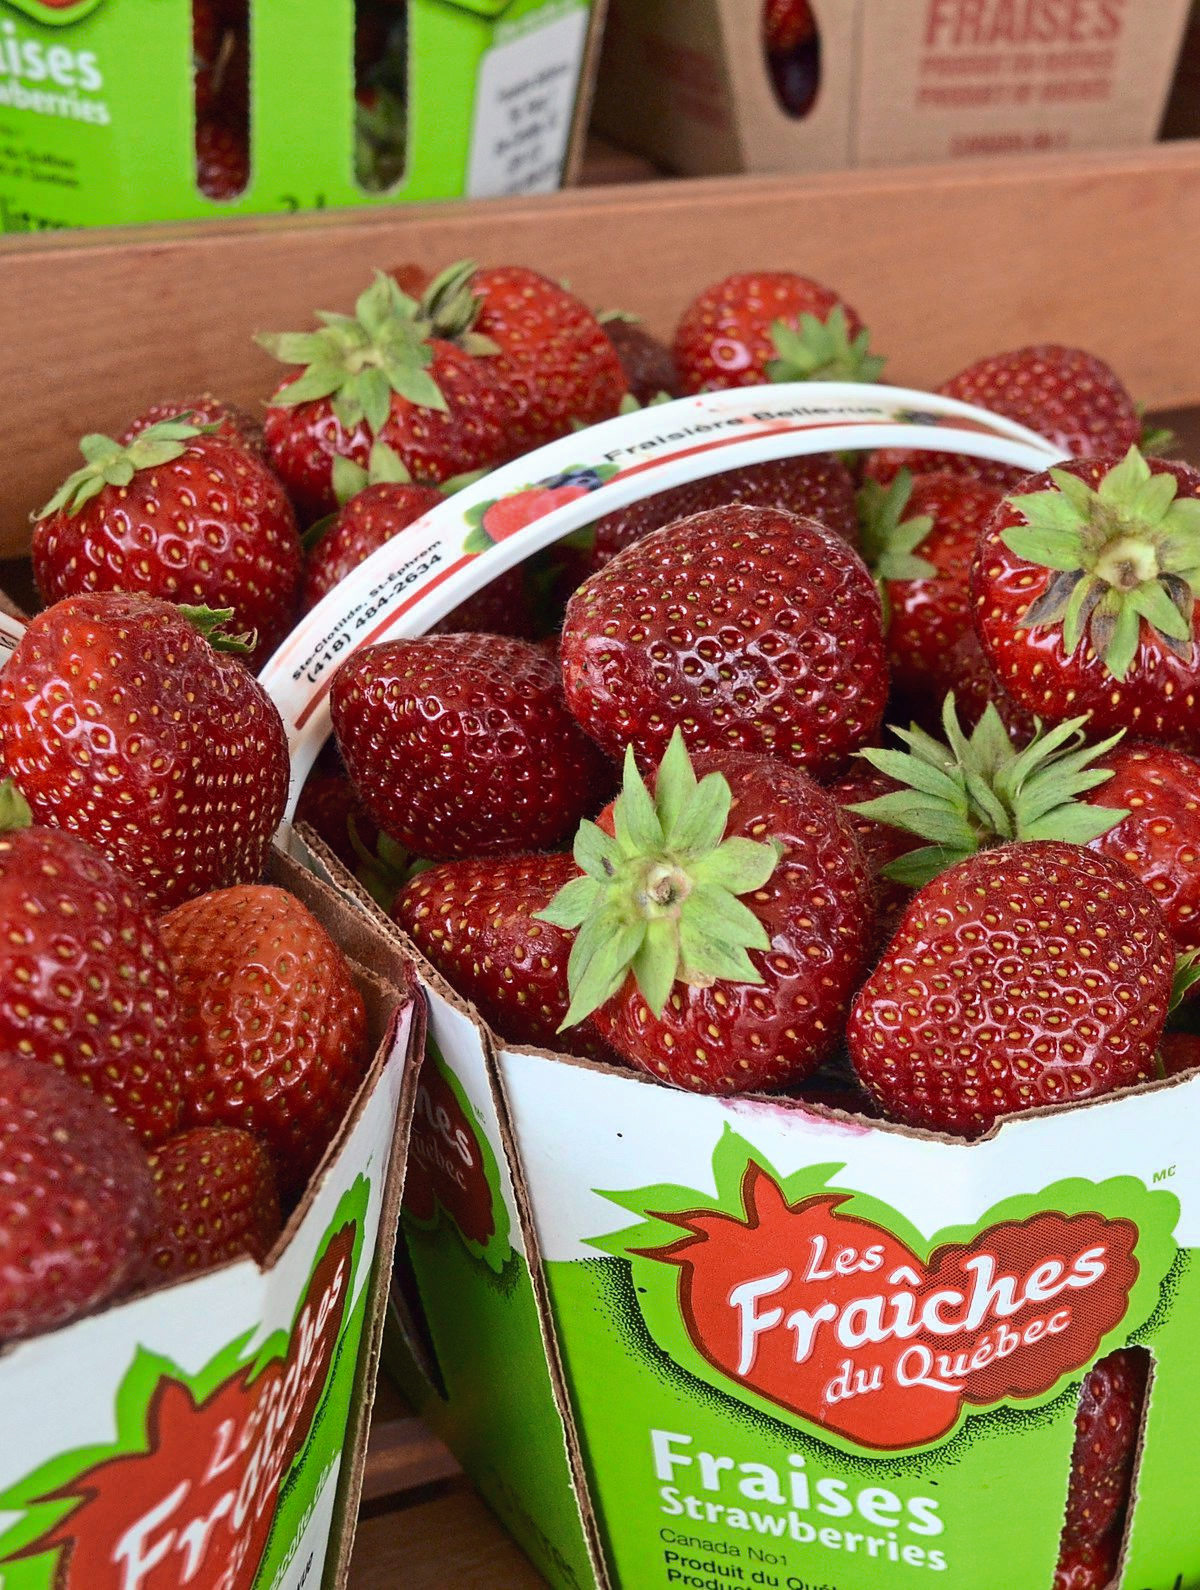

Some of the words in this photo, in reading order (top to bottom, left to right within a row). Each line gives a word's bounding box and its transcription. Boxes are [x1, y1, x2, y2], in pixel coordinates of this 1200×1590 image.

[307, 633, 351, 683] (418)
[355, 554, 442, 629] 484-2634
[1152, 1164, 1177, 1184] MC
[802, 1234, 885, 1283] Les
[729, 1246, 1106, 1376] Fraîches
[825, 1359, 882, 1403] du
[896, 1306, 1071, 1393] Québec
[650, 1428, 944, 1537] Fraises
[659, 1486, 948, 1572] Strawberries
[659, 1528, 741, 1557] Canada
[748, 1546, 788, 1567] No1
[664, 1549, 744, 1581] Produit
[751, 1570, 779, 1587] du
